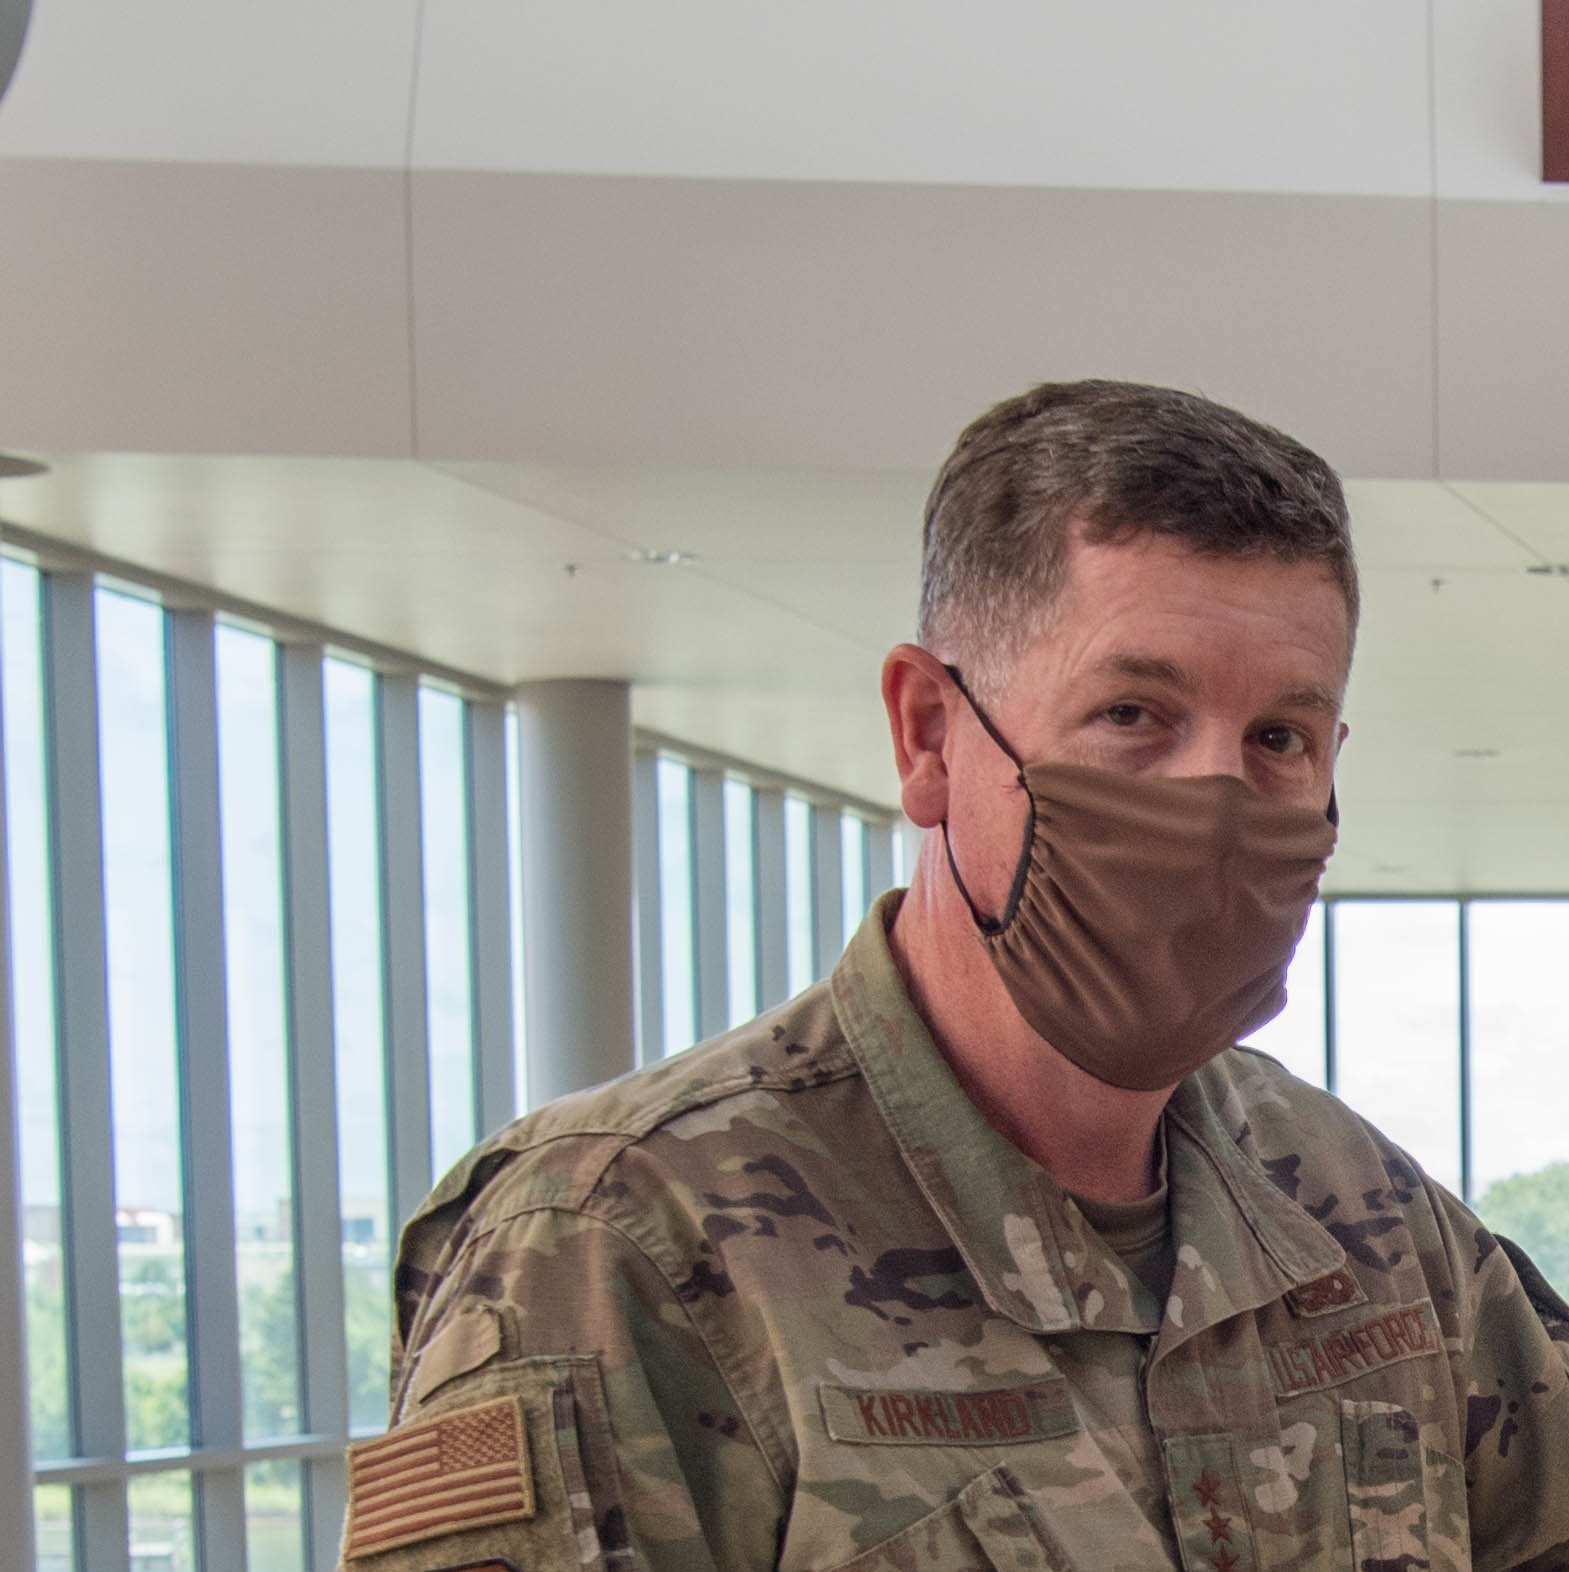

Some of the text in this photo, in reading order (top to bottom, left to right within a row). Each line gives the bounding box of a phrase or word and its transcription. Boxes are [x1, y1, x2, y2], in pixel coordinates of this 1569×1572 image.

[1310, 1328, 1364, 1383] AIR
[1351, 1306, 1440, 1367] FORCE
[856, 1392, 1032, 1438] KIRKLAND
